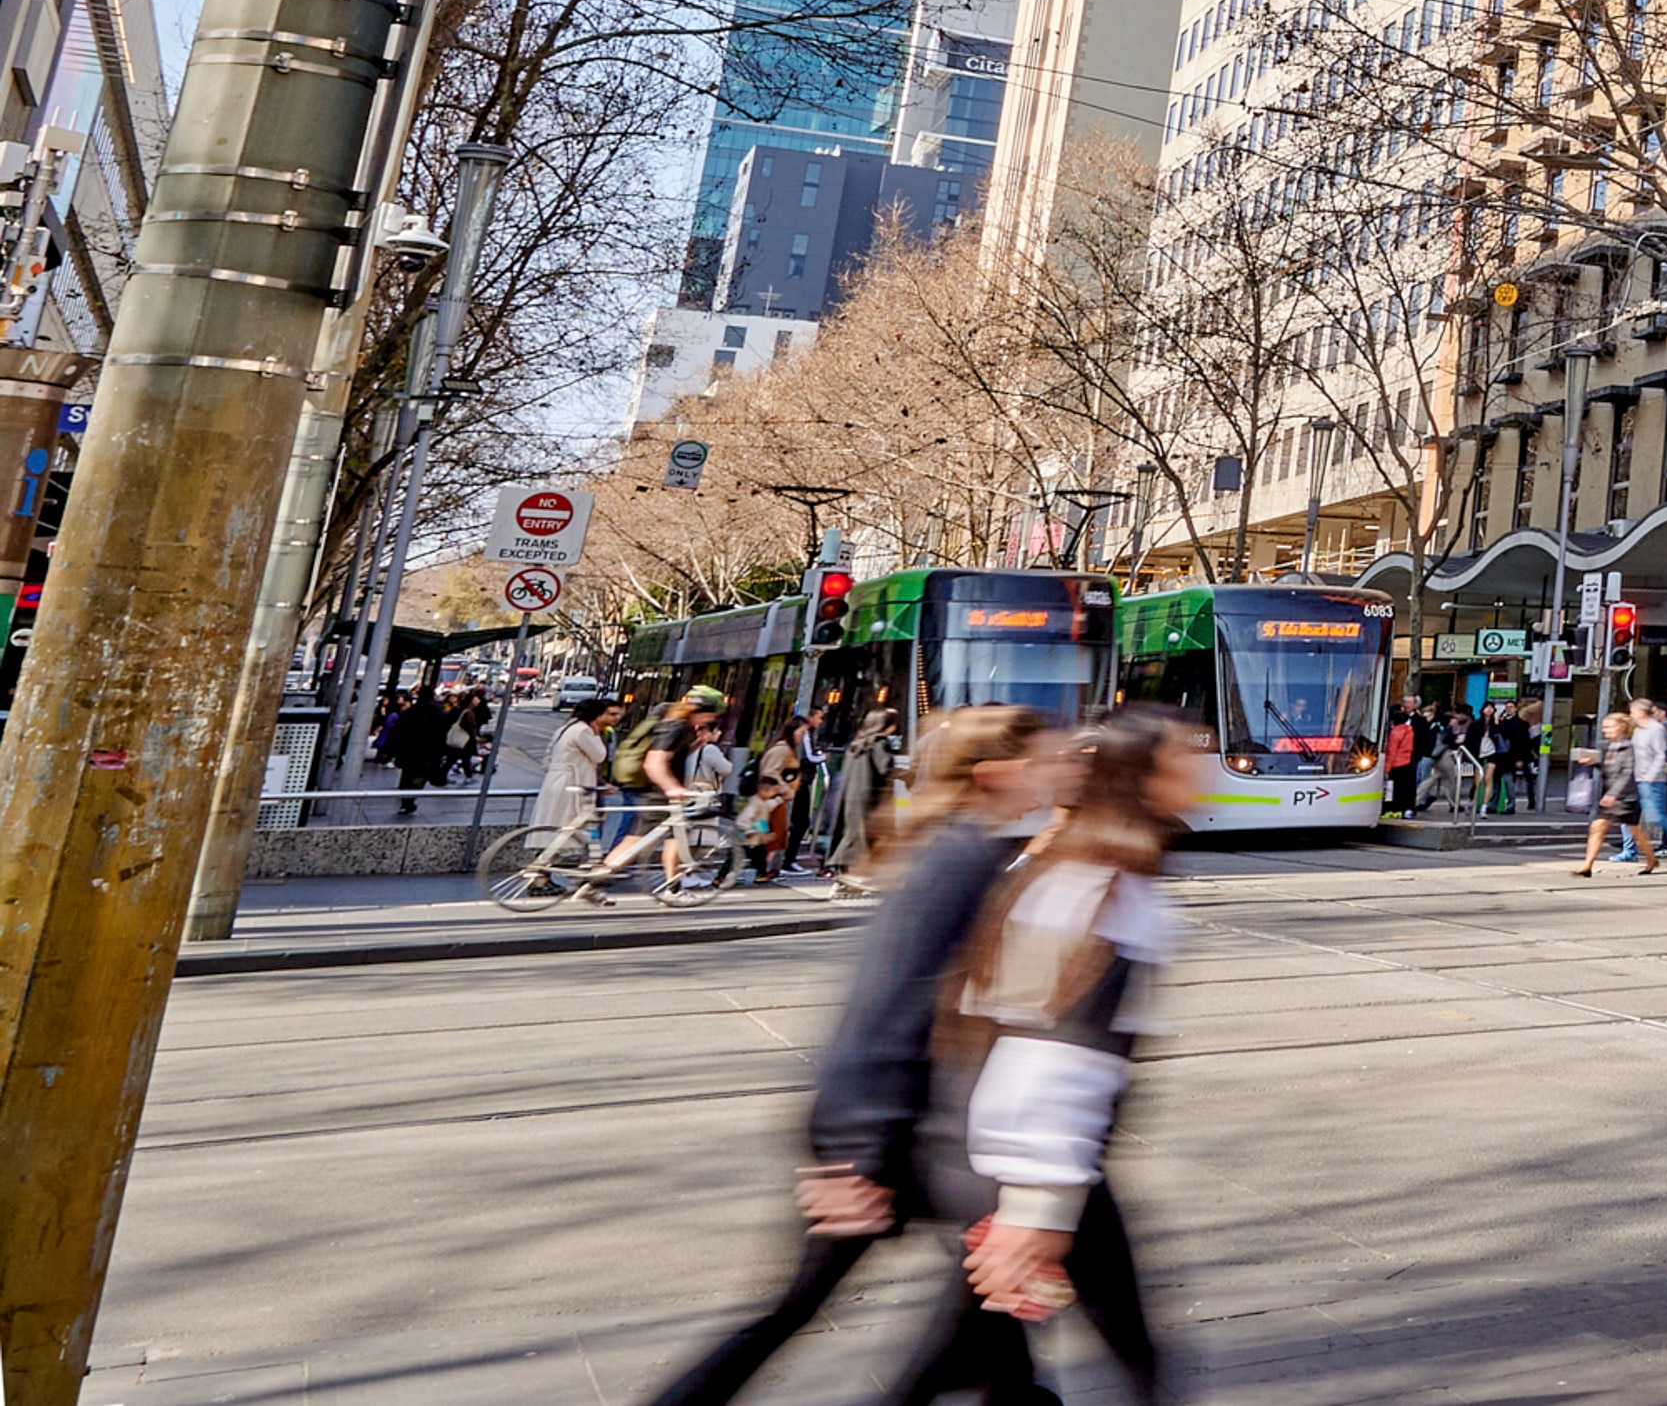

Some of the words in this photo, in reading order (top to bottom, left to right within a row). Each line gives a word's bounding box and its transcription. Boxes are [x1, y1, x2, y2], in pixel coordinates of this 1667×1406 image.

[668, 469, 699, 479] ONLY
[538, 498, 557, 508] NO
[522, 519, 564, 530] ENTRY
[515, 537, 559, 550] TRAMS
[499, 548, 568, 561] EXCEPTED
[1363, 604, 1393, 618] 6083
